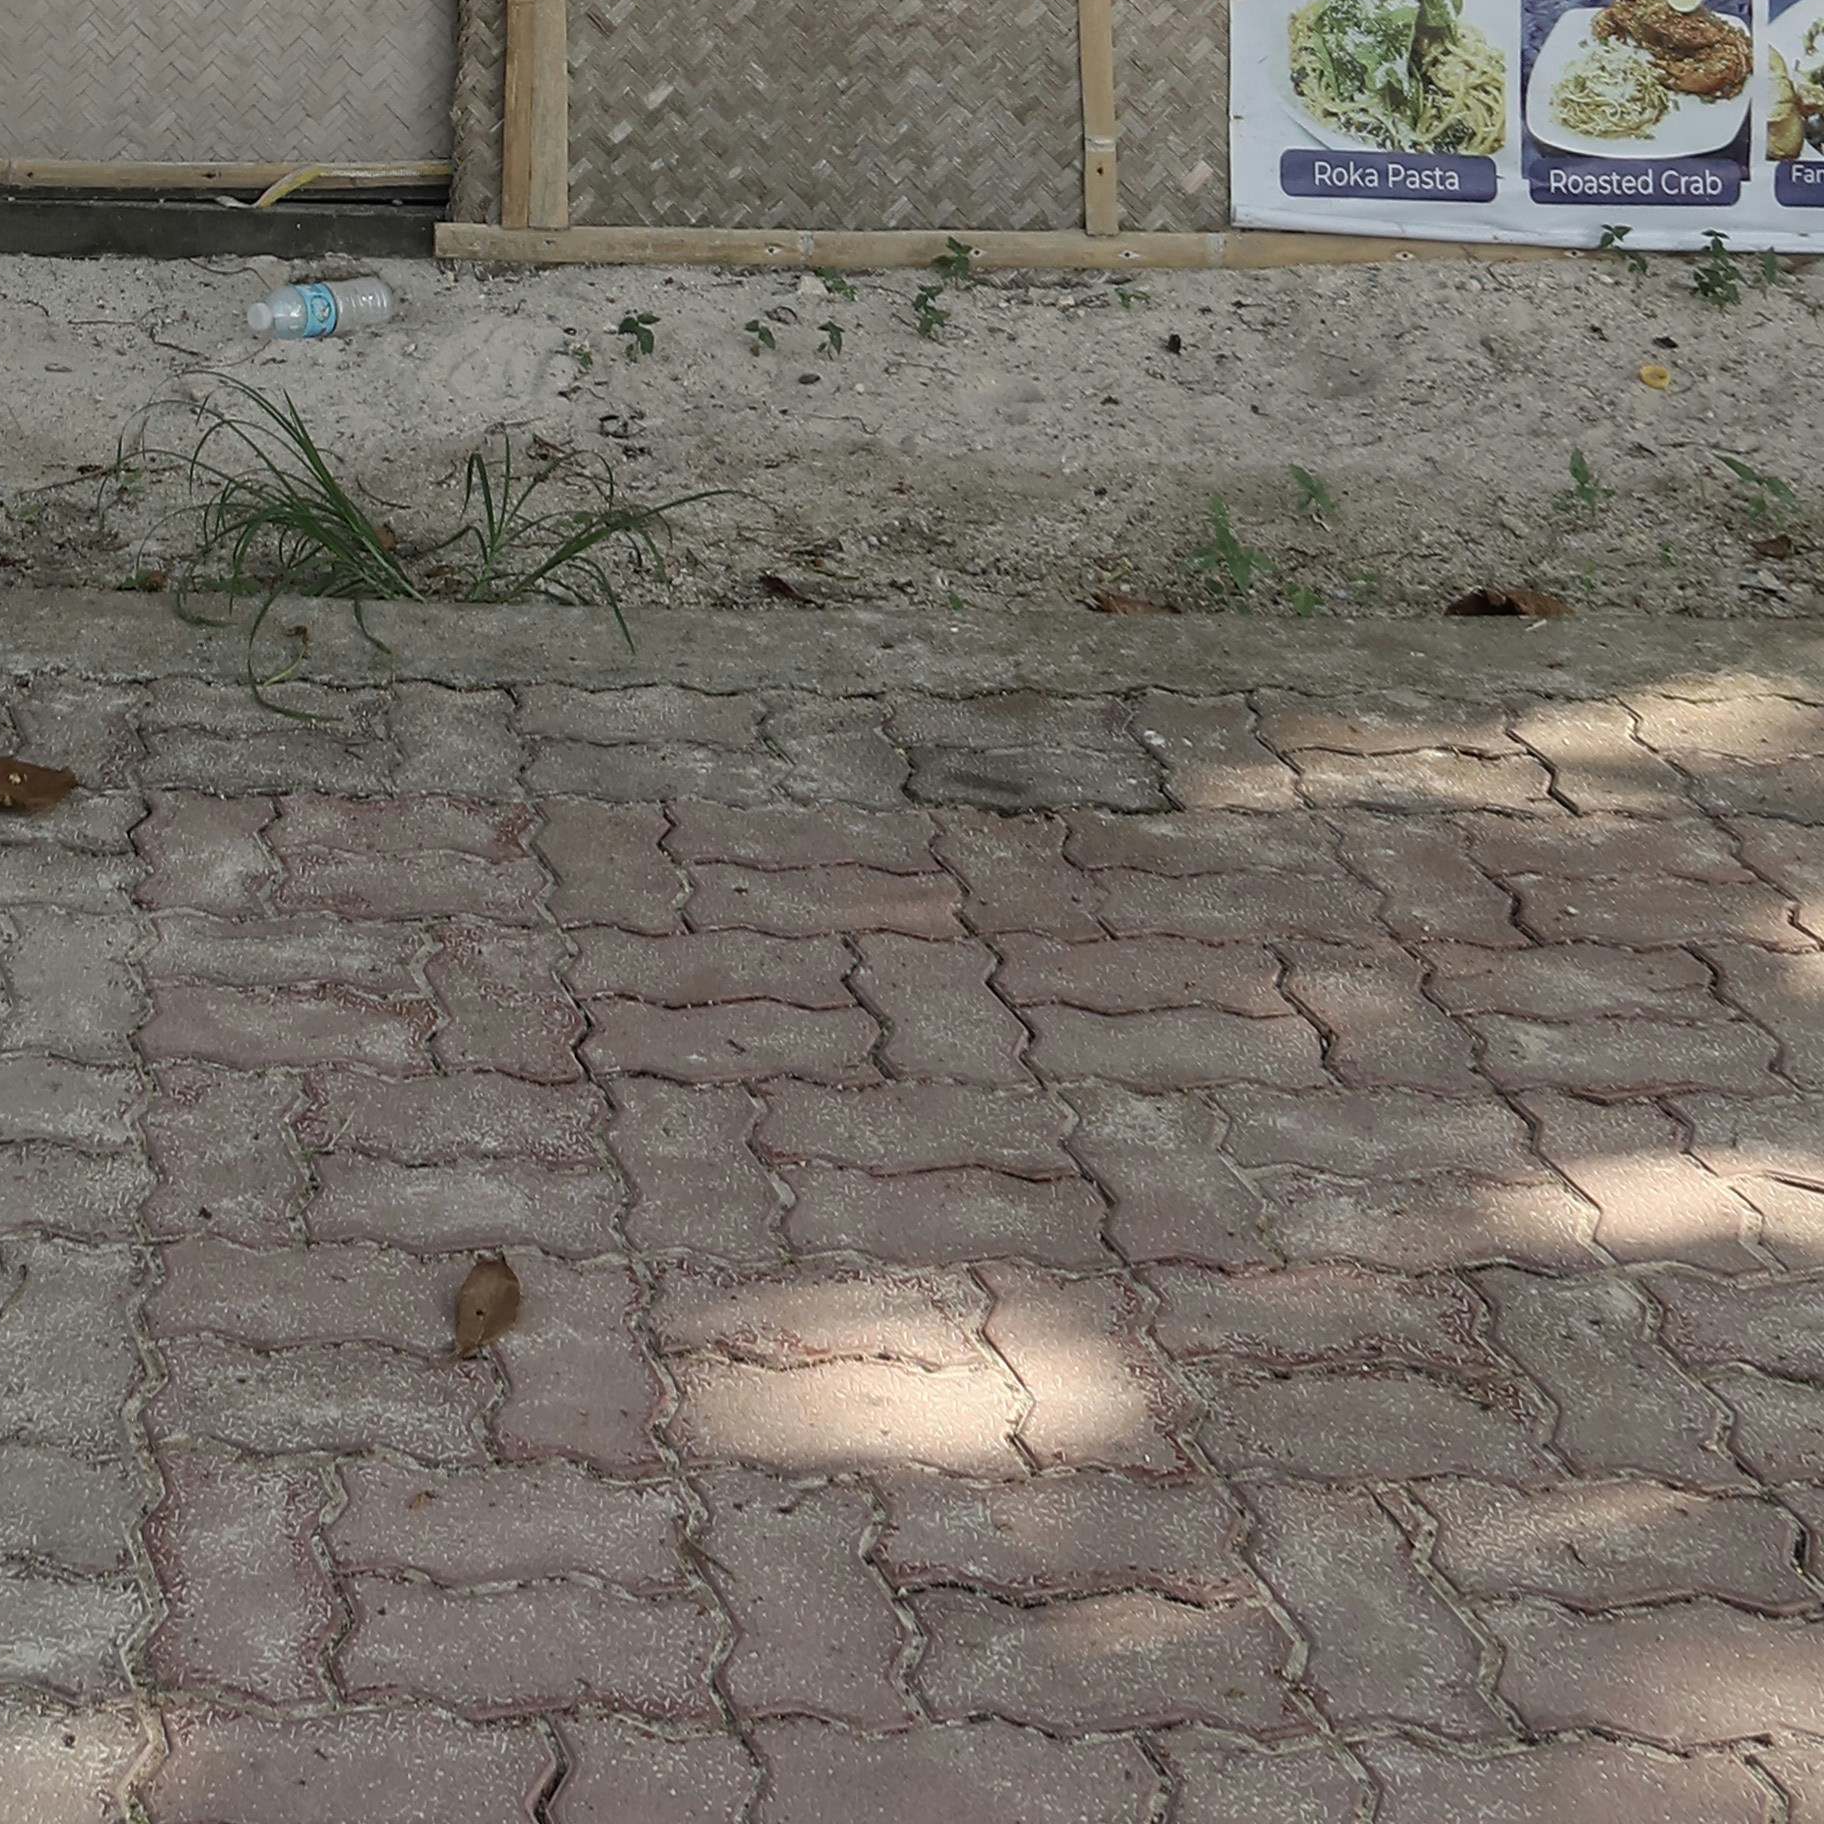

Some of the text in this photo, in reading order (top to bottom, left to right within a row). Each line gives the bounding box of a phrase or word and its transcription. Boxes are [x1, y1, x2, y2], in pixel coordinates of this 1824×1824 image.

[1314, 160, 1460, 191] Roka Pasta
[1550, 169, 1723, 196] Roasted Crab
